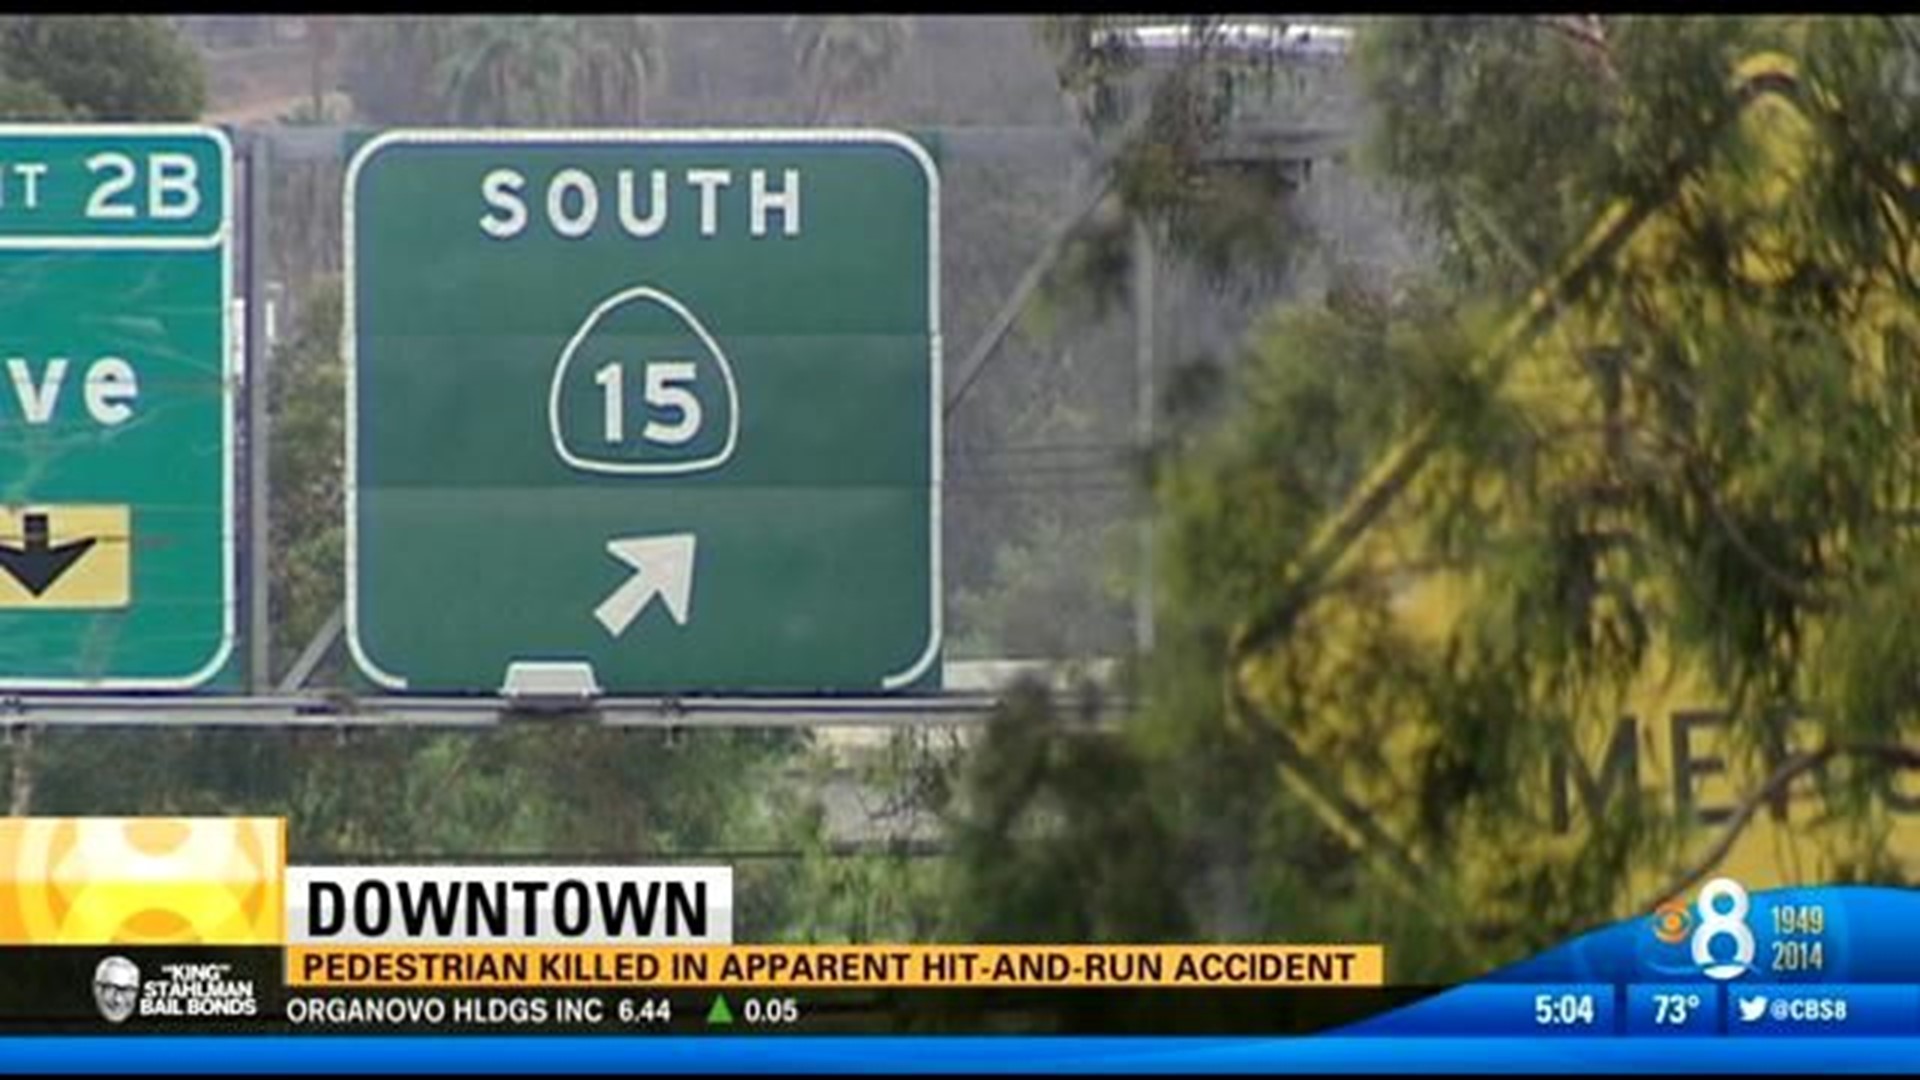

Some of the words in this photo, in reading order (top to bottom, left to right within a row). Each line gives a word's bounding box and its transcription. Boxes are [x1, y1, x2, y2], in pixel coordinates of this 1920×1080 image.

[85, 153, 200, 219] 2B
[479, 168, 800, 238] SOUTH
[6, 356, 138, 426] ve
[595, 361, 702, 445] 15
